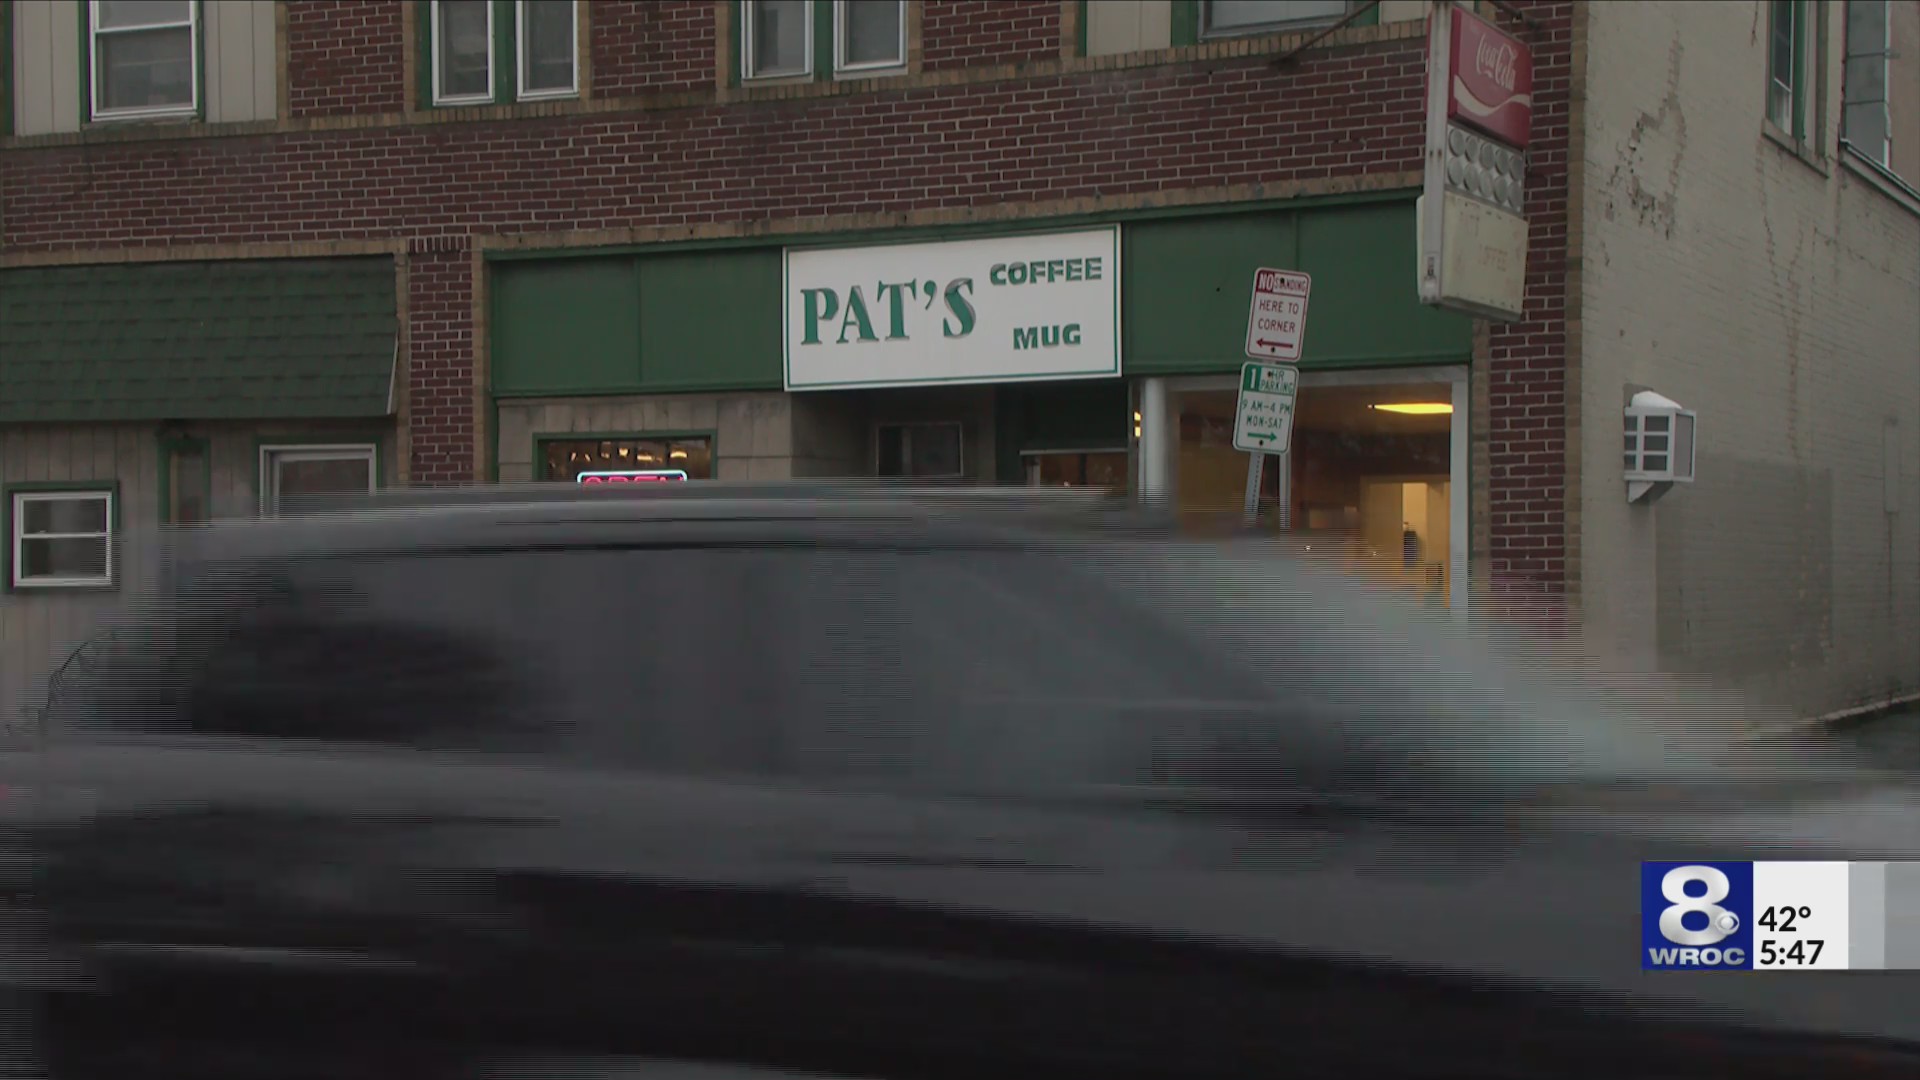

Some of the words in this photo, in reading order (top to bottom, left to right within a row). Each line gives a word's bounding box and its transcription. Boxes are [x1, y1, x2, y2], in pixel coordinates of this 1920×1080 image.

[990, 257, 1102, 286] COFFEE
[1258, 272, 1274, 291] NO
[800, 277, 977, 345] PAT'S
[1259, 300, 1283, 313] HERE
[1288, 302, 1299, 315] TO
[1258, 318, 1296, 333] CORNER
[1013, 323, 1081, 350] MUG
[1250, 368, 1257, 390] 1
[1271, 369, 1285, 382] HR
[1259, 378, 1294, 394] PARKING
[1241, 398, 1249, 410] 9
[1279, 402, 1291, 415] PM
[1246, 414, 1283, 430] MON-SAT
